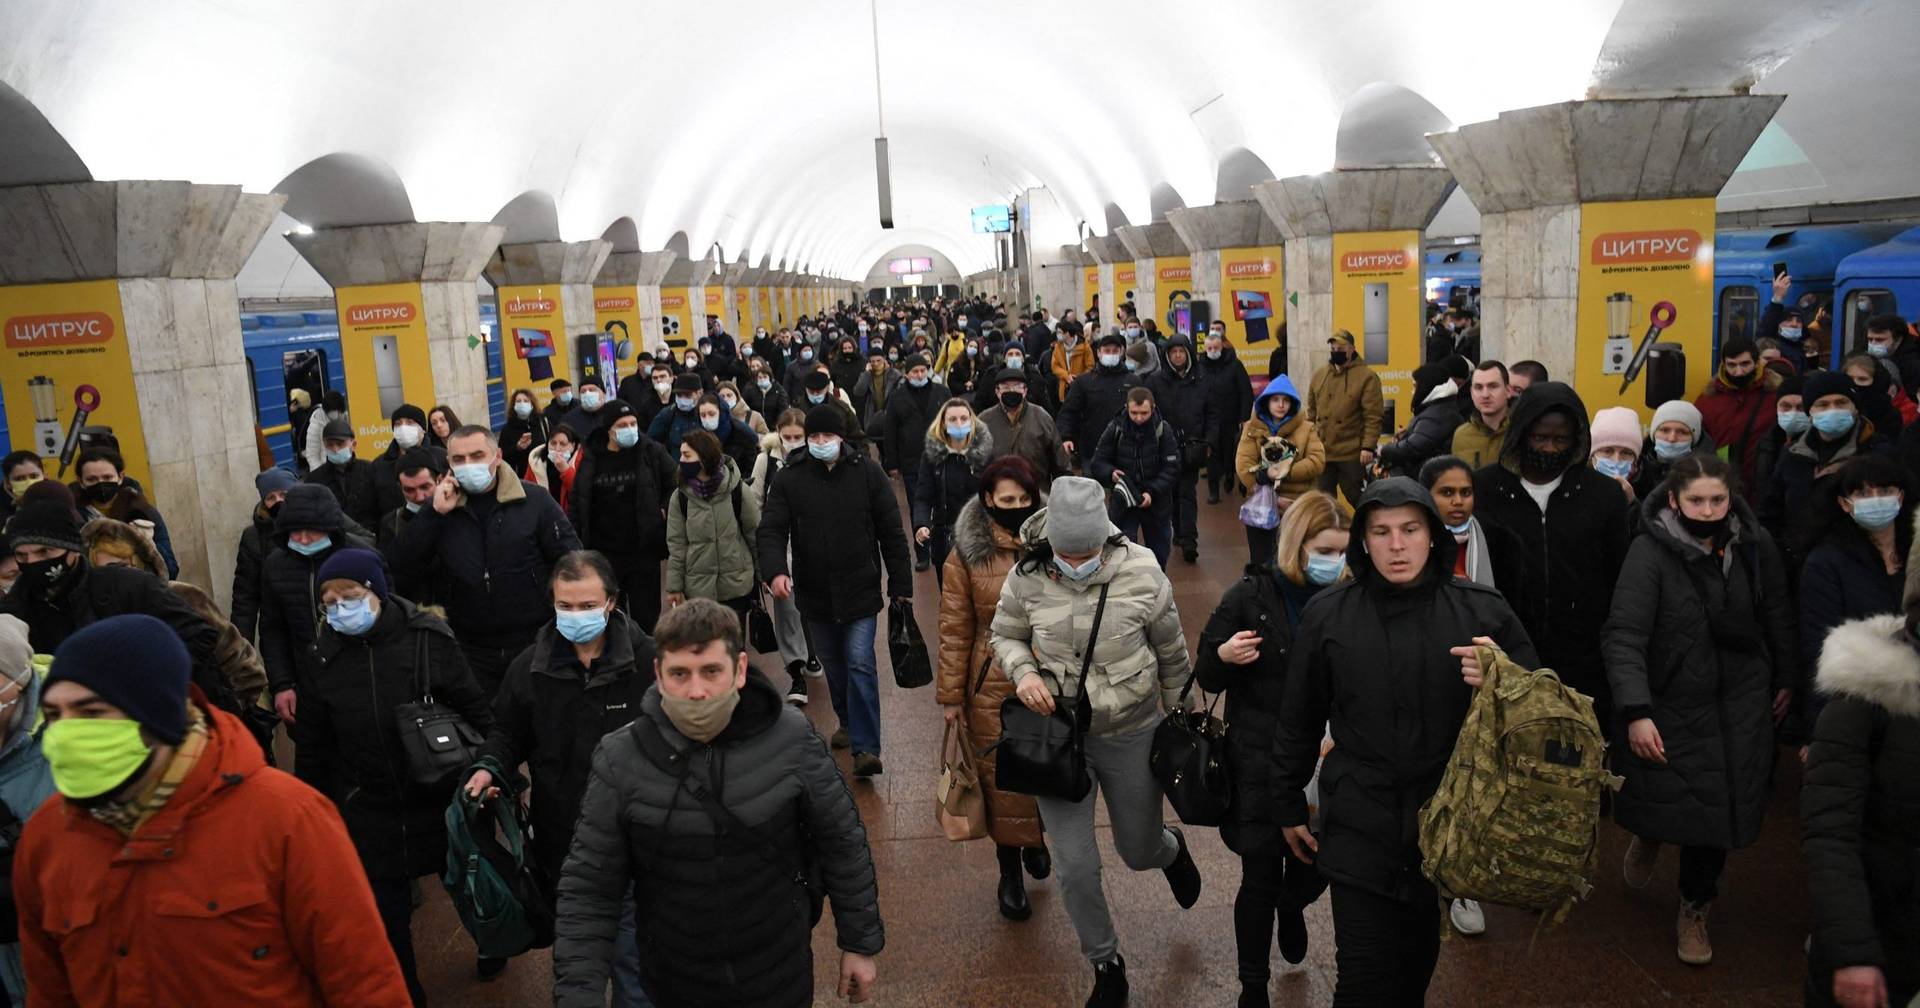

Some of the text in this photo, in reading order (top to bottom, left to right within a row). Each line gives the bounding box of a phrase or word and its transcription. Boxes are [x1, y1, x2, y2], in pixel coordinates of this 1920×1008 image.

[1602, 237, 1690, 258] ЦИТРУС
[1230, 262, 1271, 274] ЦИТРУС
[1347, 254, 1403, 269] ЦИТРУС
[1162, 269, 1191, 278] ЦИТРУ
[509, 301, 551, 313] ЦИТРУС
[597, 299, 631, 309] ЦИТРУС
[352, 306, 409, 321] ЦИТРУС
[14, 319, 102, 341] ЦИТРУС
